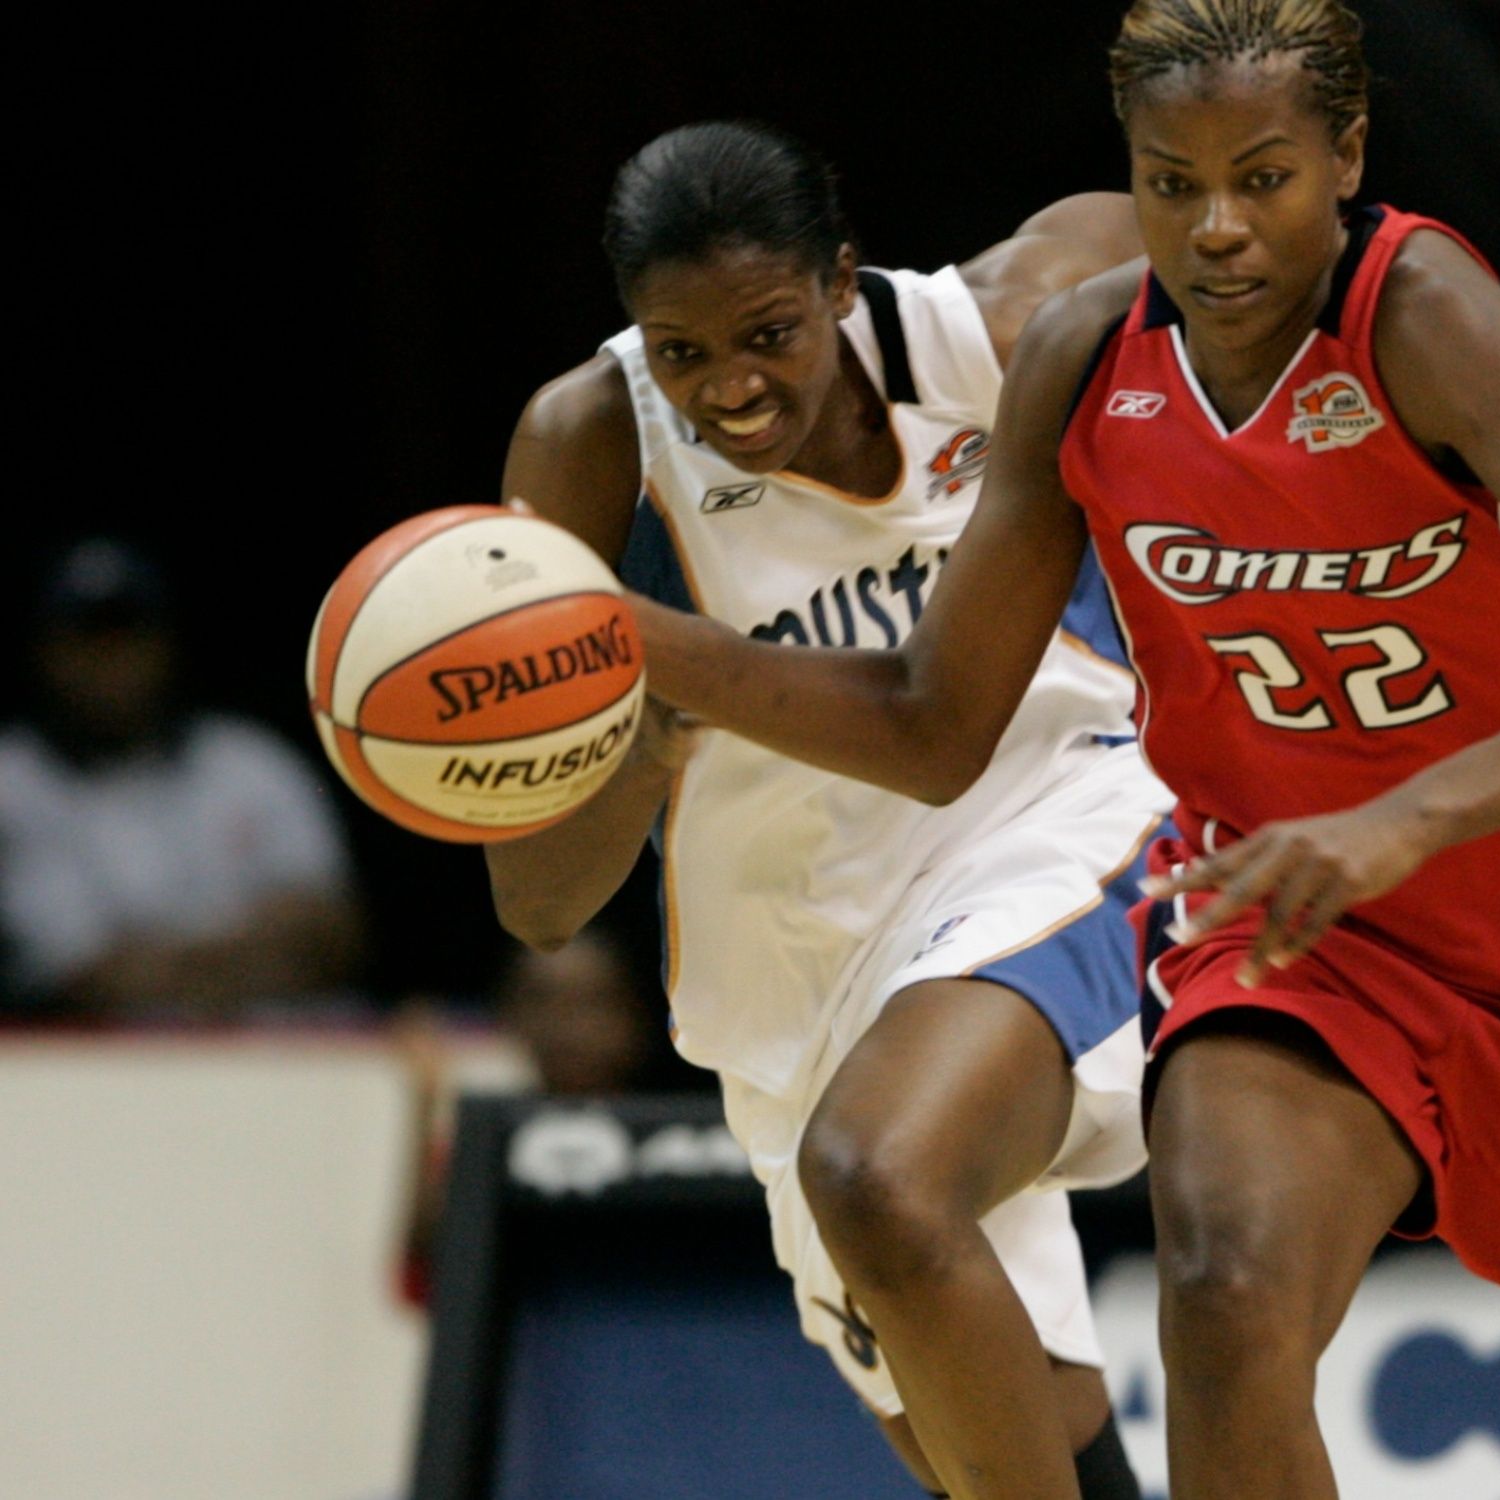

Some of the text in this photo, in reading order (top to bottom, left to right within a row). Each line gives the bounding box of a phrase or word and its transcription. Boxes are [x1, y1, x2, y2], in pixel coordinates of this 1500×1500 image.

[1123, 511, 1468, 605] COMETS
[429, 615, 634, 723] SPALDING
[1203, 620, 1456, 732] 22
